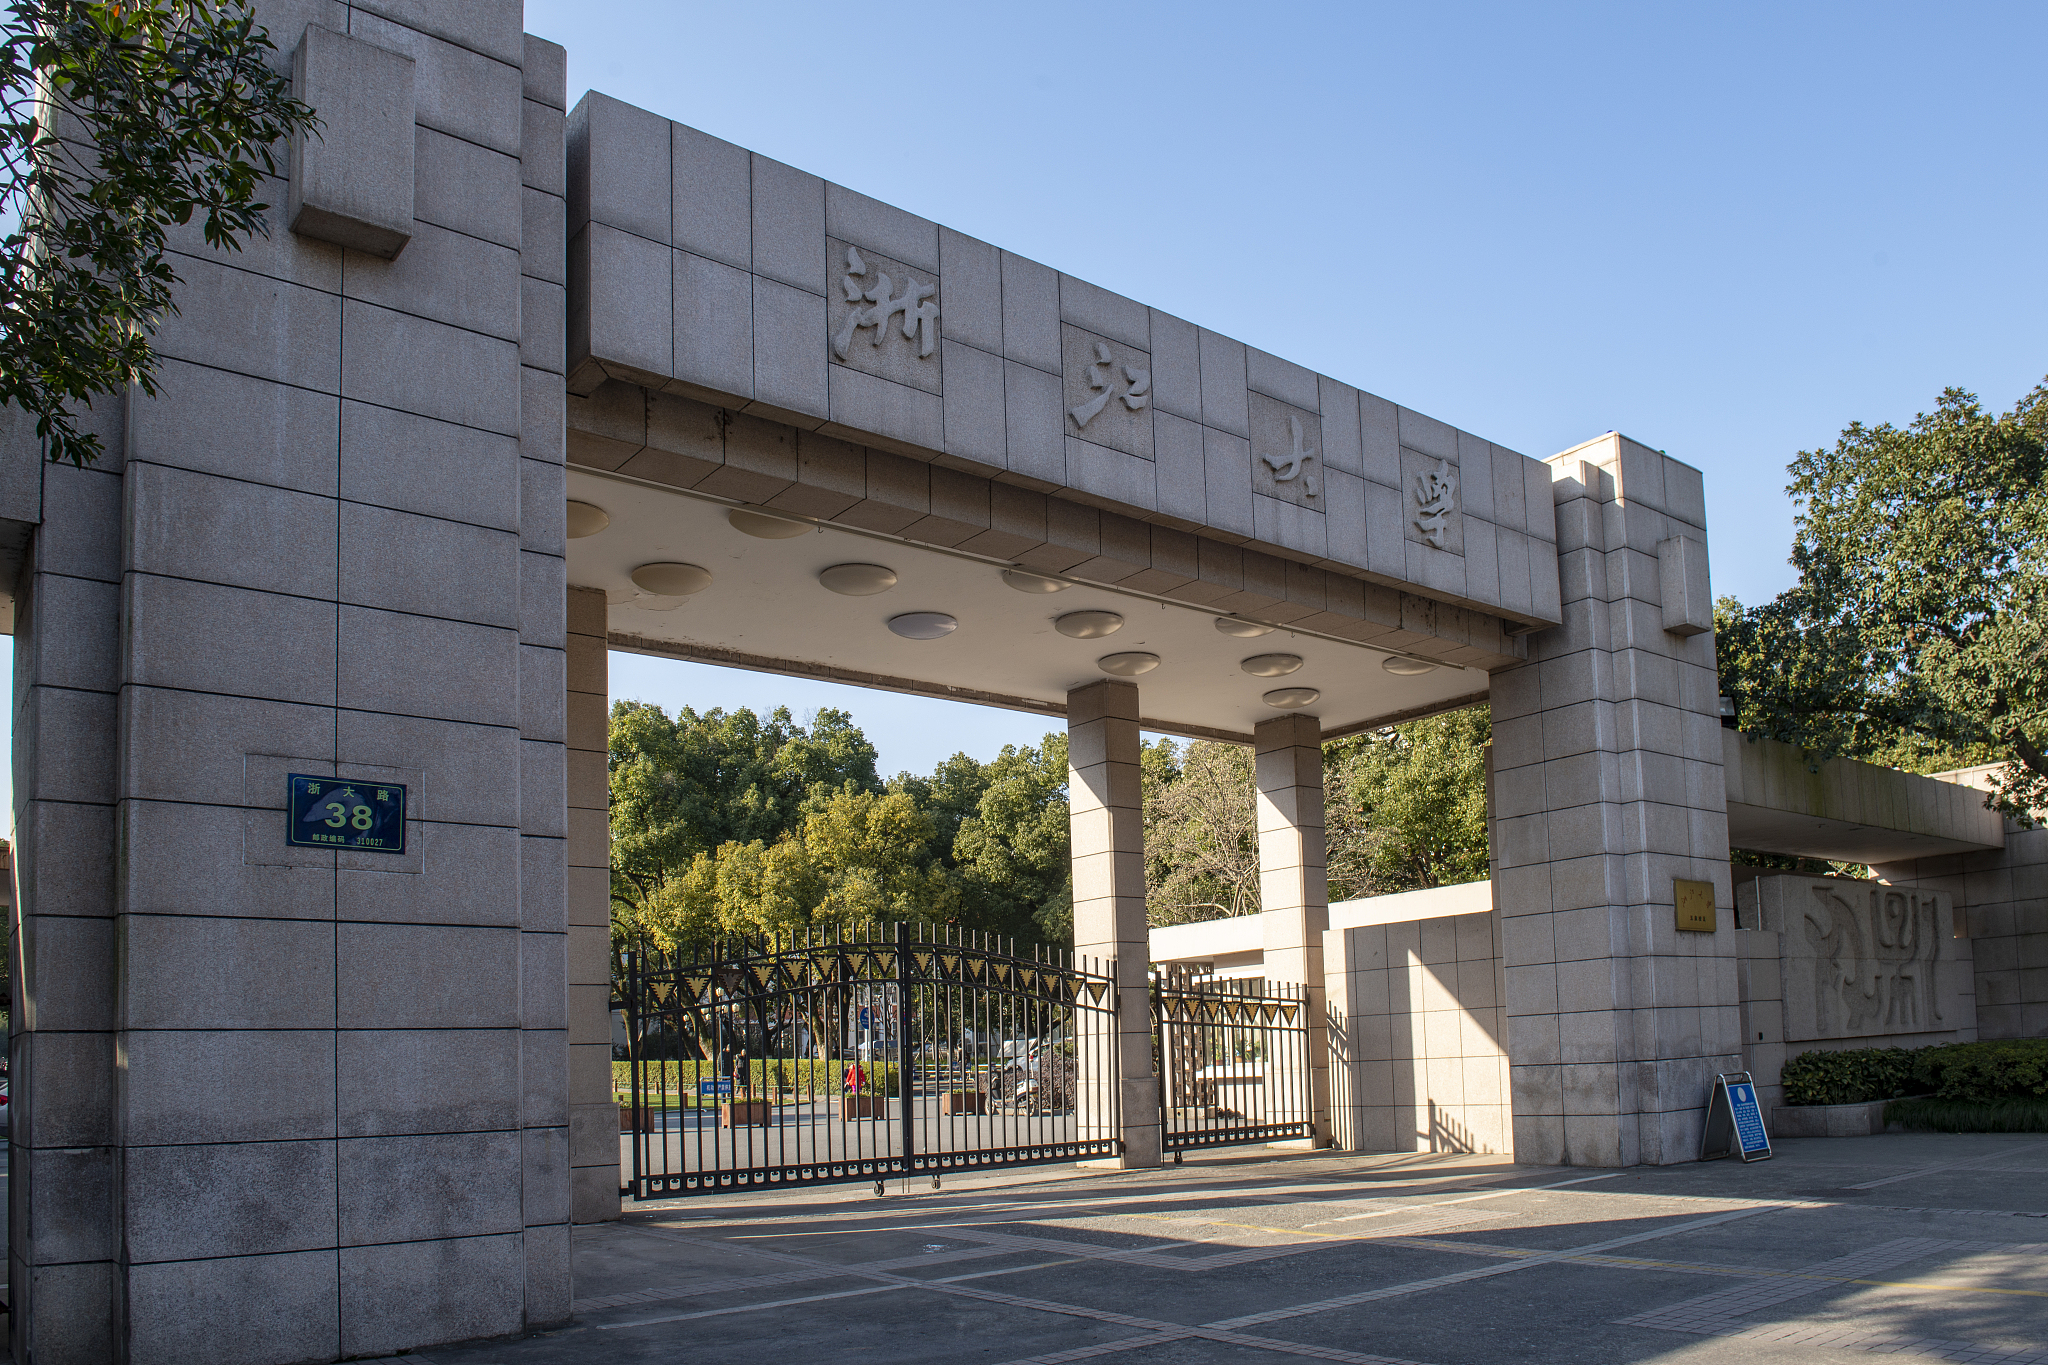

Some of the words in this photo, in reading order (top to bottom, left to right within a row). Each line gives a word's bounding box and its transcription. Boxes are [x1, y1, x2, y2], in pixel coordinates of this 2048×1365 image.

[307, 782, 389, 802] 浙大路
[324, 802, 373, 830] 38
[312, 833, 345, 844] 邮政编码
[356, 837, 383, 847] 310027
